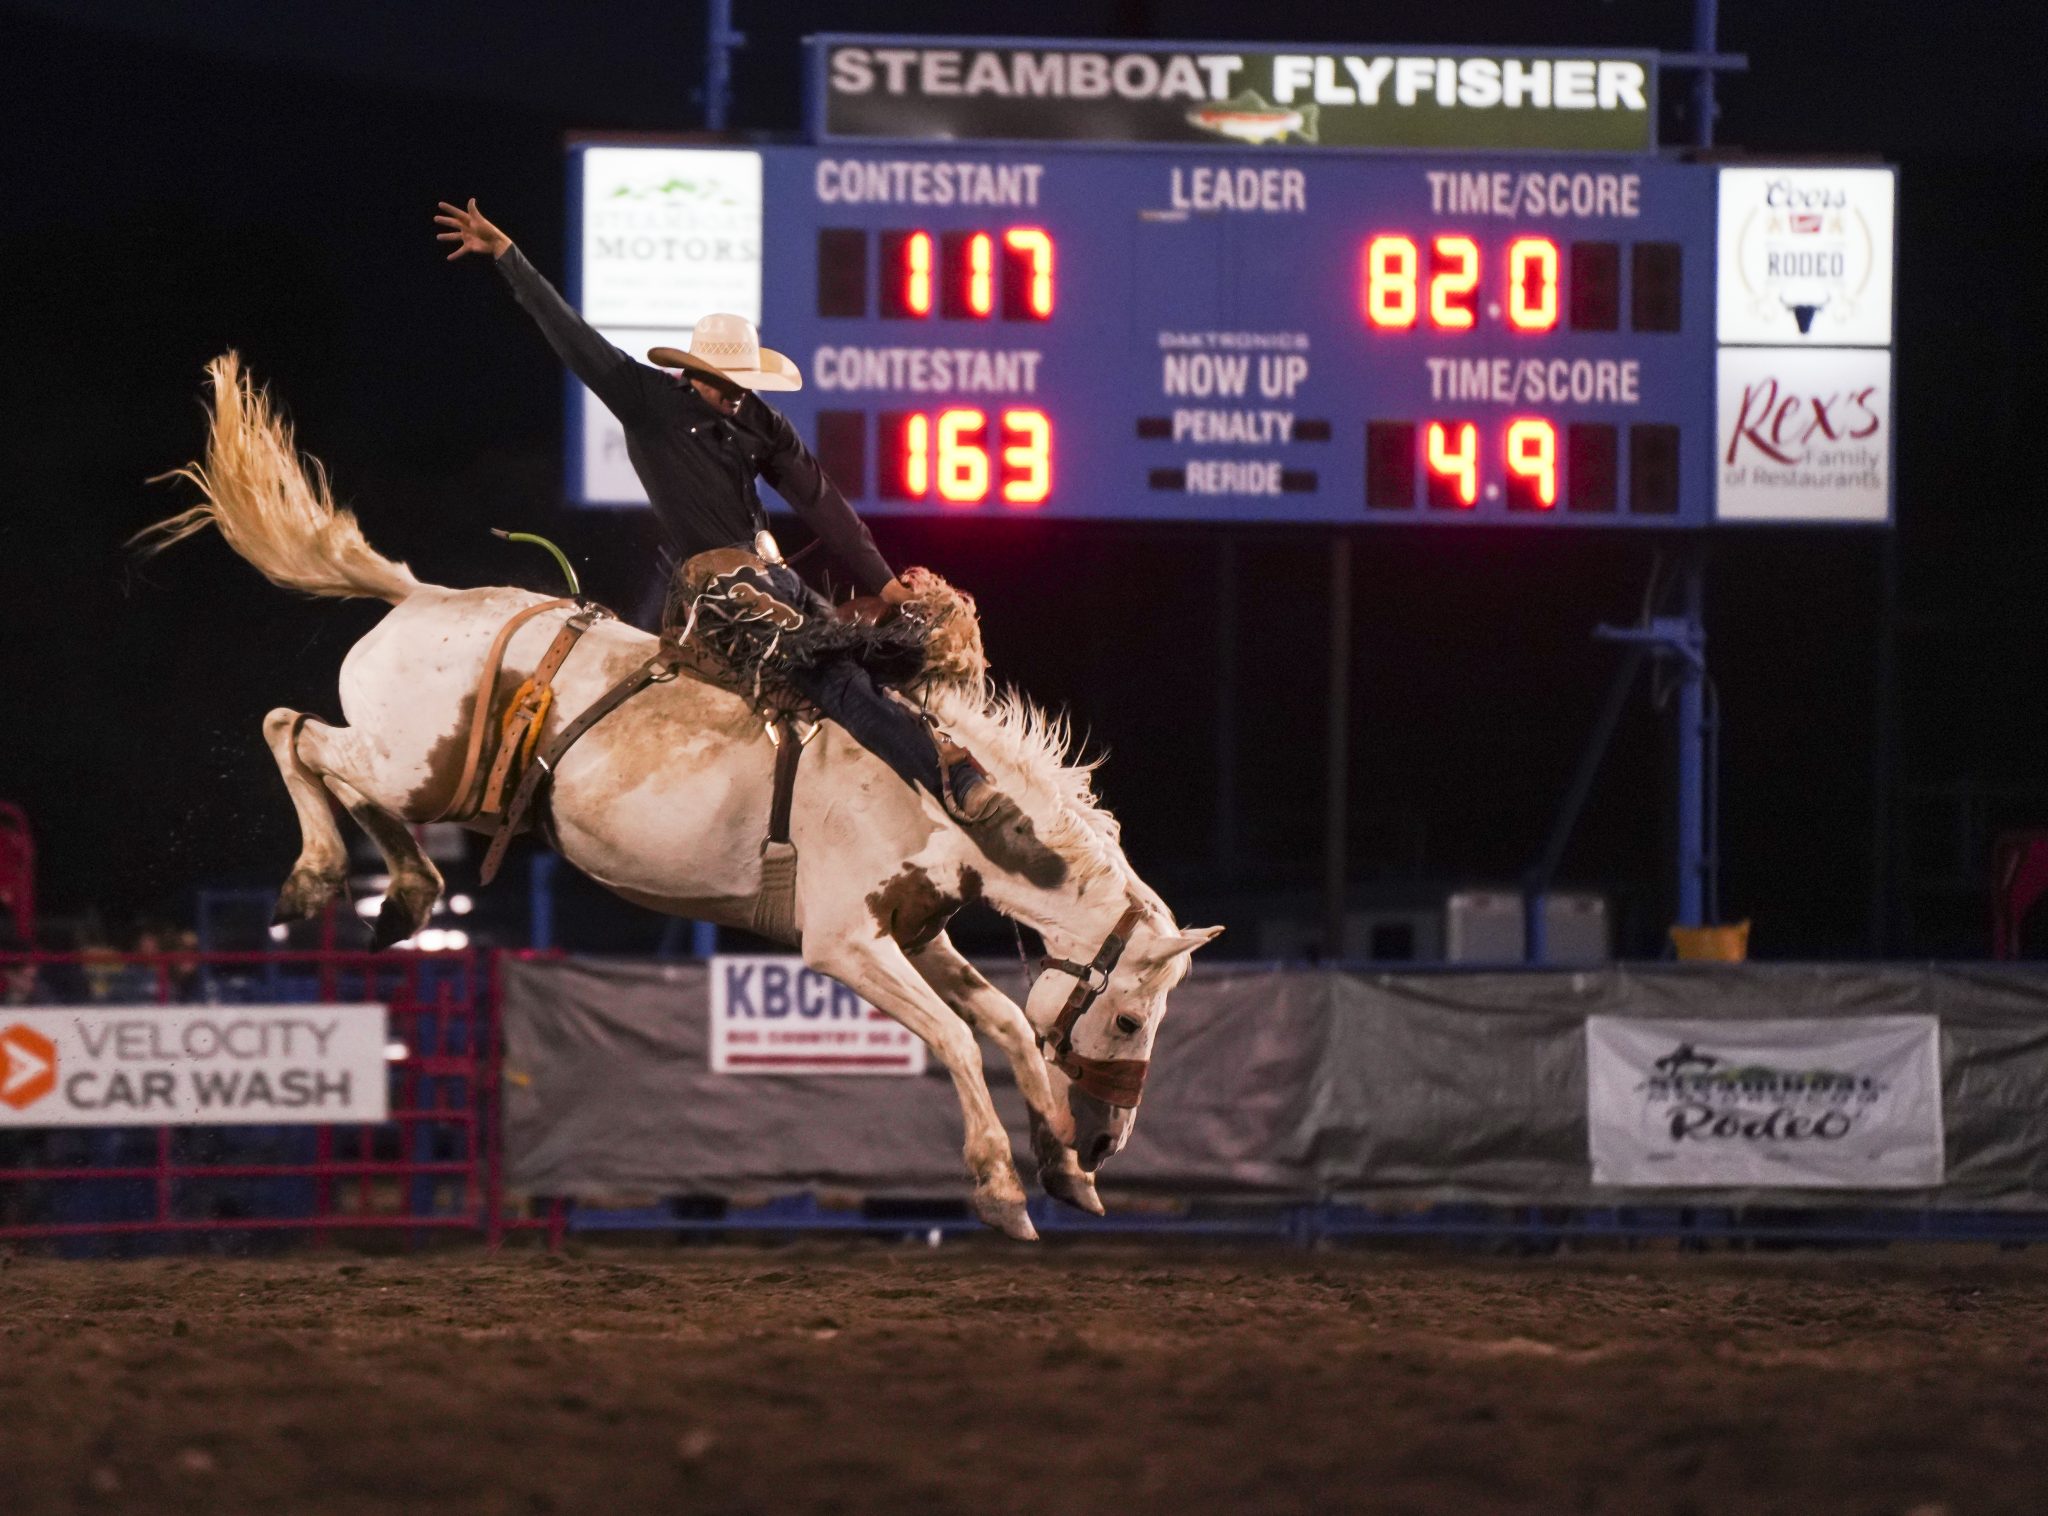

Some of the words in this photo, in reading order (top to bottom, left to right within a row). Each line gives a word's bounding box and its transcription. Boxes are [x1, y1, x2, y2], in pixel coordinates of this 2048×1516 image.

[832, 48, 1243, 100] STEAMBOAT
[1273, 56, 1646, 110] FLYFISHER
[815, 159, 1043, 207] CONTESTANT
[1171, 167, 1306, 212] LEADER
[1427, 171, 1640, 218] TIME/SCORE
[594, 235, 758, 262] MOTORS
[1767, 251, 1844, 277] RODEO
[907, 228, 1055, 316] 117
[813, 346, 1042, 392] CONTESTANT
[1163, 353, 1249, 397] NOW
[1259, 355, 1308, 398] UP
[1427, 357, 1640, 404] TIME/SCORE
[1172, 408, 1295, 445] PENALTY
[1726, 376, 1880, 468] Rex's
[907, 408, 1054, 505] 163
[1185, 460, 1283, 496] RERIDE
[1752, 467, 1881, 489] Restaurants
[76, 1019, 339, 1062] VELOCITY
[65, 1070, 178, 1110] CAR
[191, 1070, 354, 1109] WASH
[1667, 1103, 1851, 1142] Rodeo
